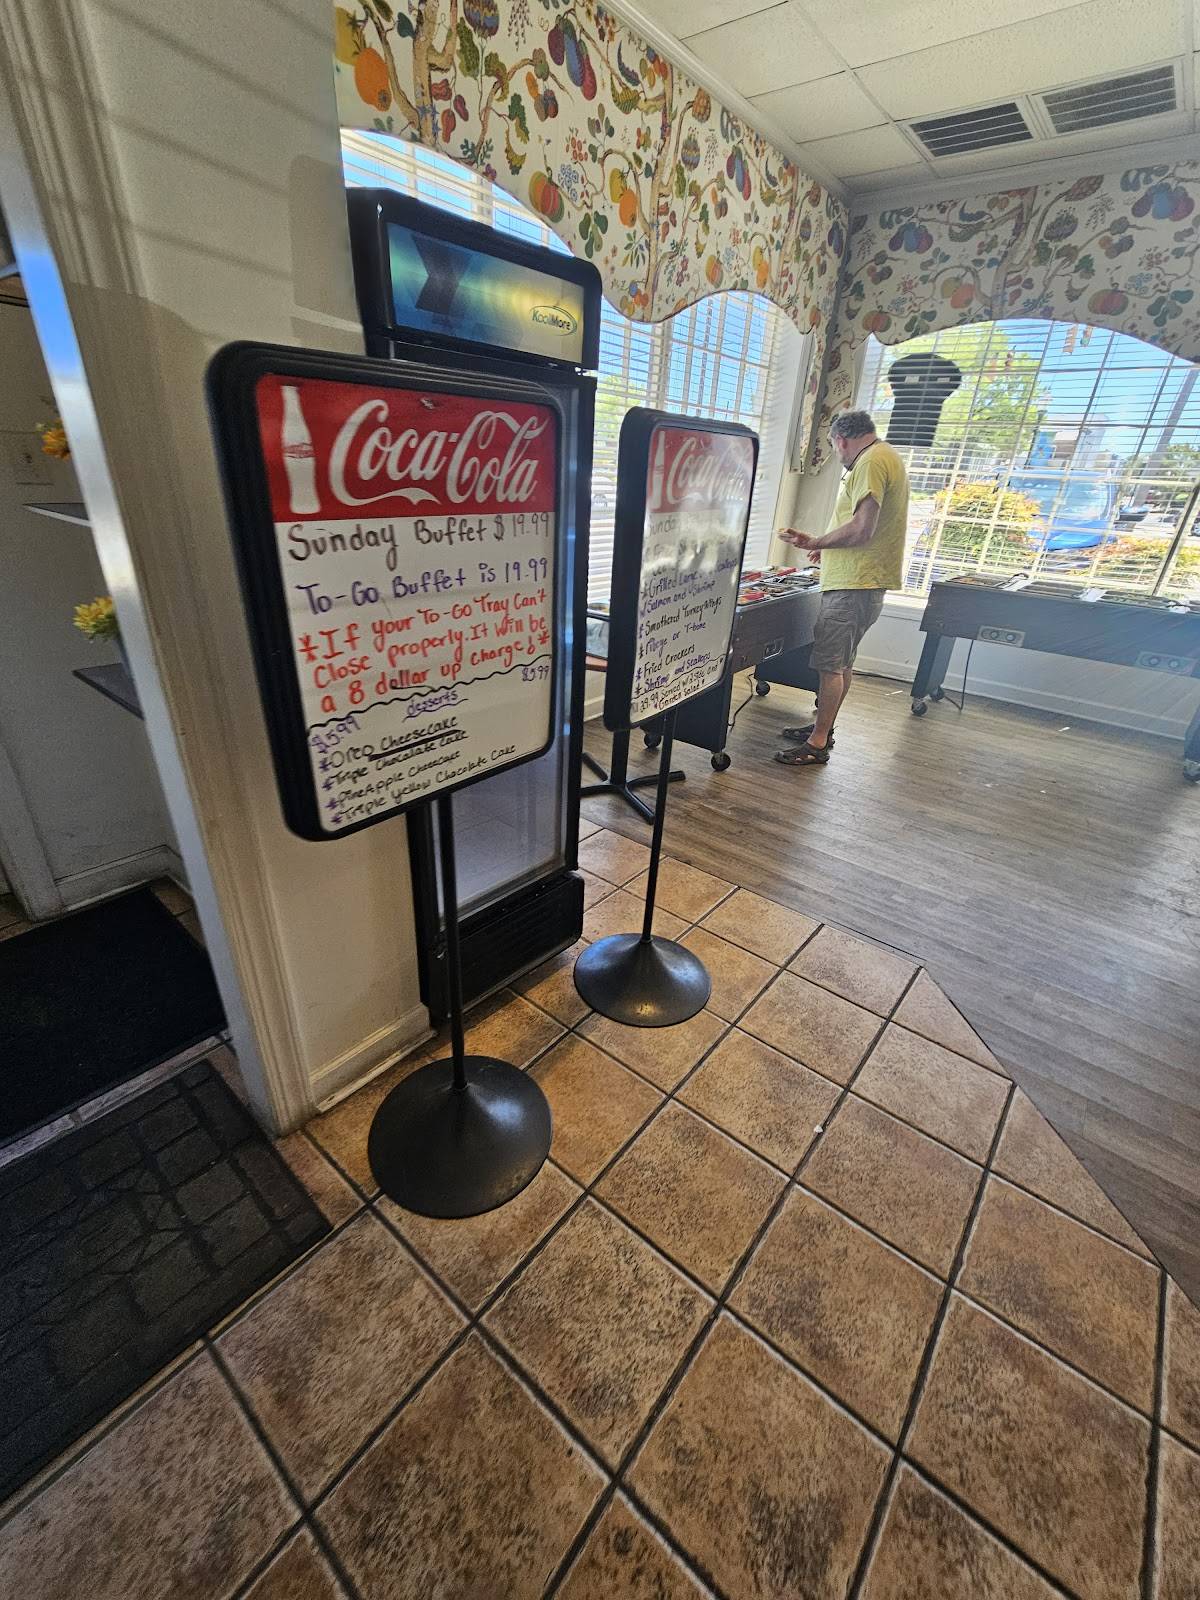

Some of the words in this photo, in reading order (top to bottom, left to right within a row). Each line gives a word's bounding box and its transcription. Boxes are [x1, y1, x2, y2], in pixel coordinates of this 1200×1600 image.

[531, 308, 572, 331] KoolMore
[330, 398, 550, 505] Coca-Cola
[288, 523, 399, 571] Sunday
[414, 516, 487, 545] Buffet
[392, 567, 466, 598] Buffet
[478, 562, 496, 582] is
[505, 557, 548, 583] 19.99
[314, 655, 372, 688] Close
[529, 613, 546, 632] be
[318, 622, 361, 659] If
[371, 616, 415, 653] your
[473, 592, 509, 623] Tray
[321, 695, 337, 713] a
[349, 680, 364, 704] 8
[376, 669, 430, 695] dollar
[440, 662, 461, 681] up
[643, 658, 663, 679] Fried
[407, 690, 458, 715] desserts
[331, 745, 375, 768] Oreo
[381, 716, 458, 751] Cheesecake
[435, 756, 487, 783] Chocolate
[491, 745, 516, 761] Cake
